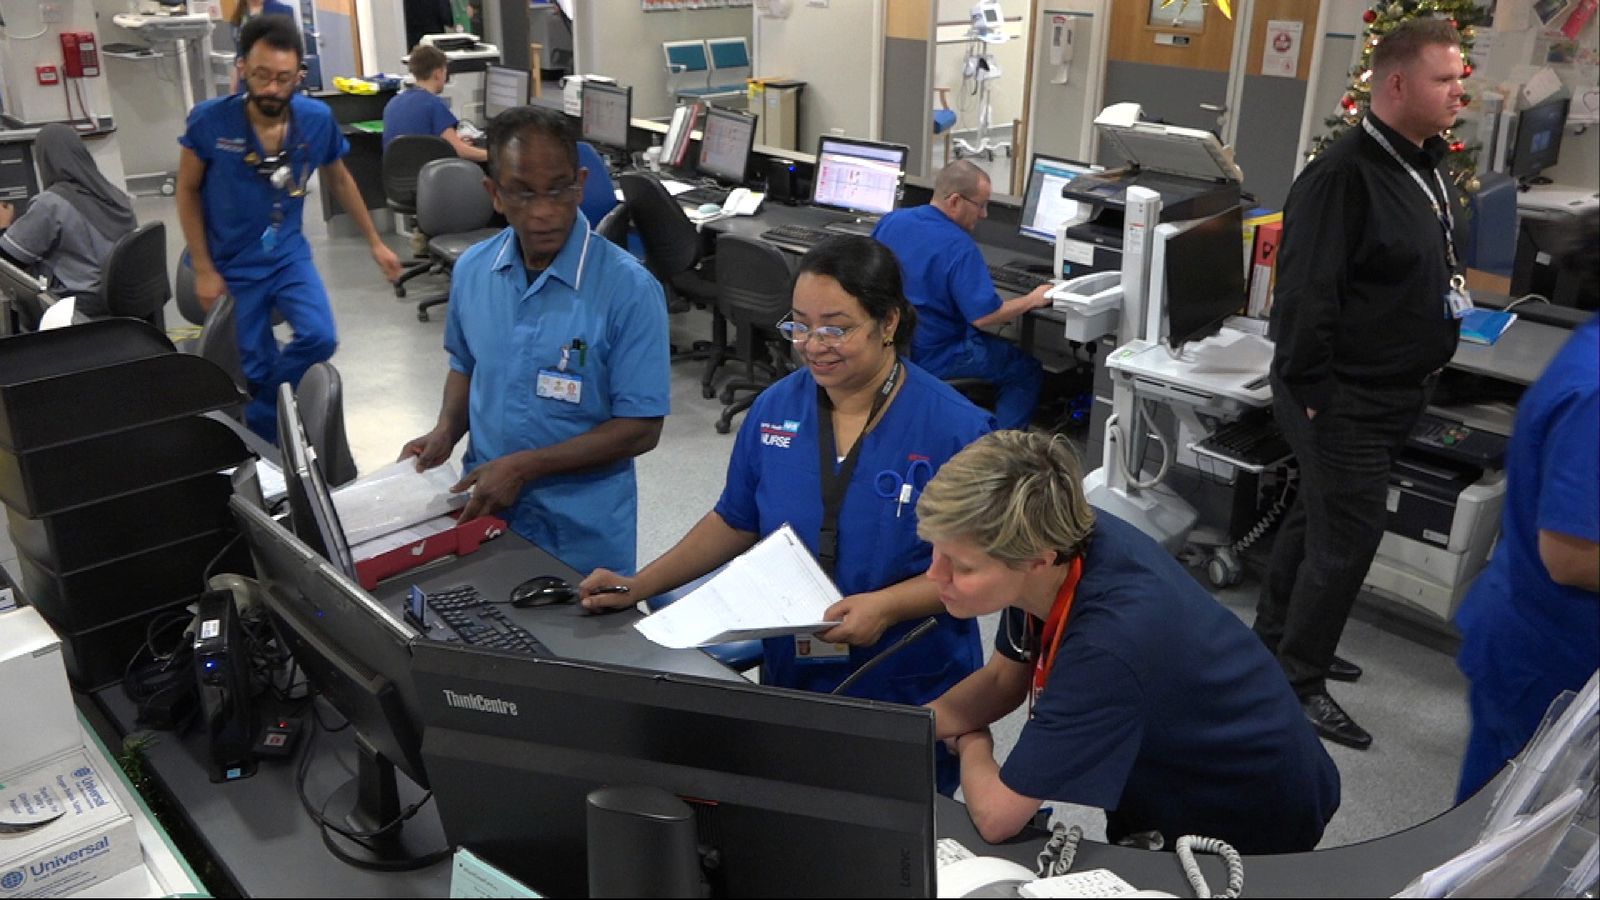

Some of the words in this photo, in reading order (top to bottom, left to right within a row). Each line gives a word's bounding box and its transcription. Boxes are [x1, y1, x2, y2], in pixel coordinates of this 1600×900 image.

[761, 433, 791, 448] NURSE
[443, 690, 518, 716] ThinkCentre
[30, 836, 109, 876] Universal
